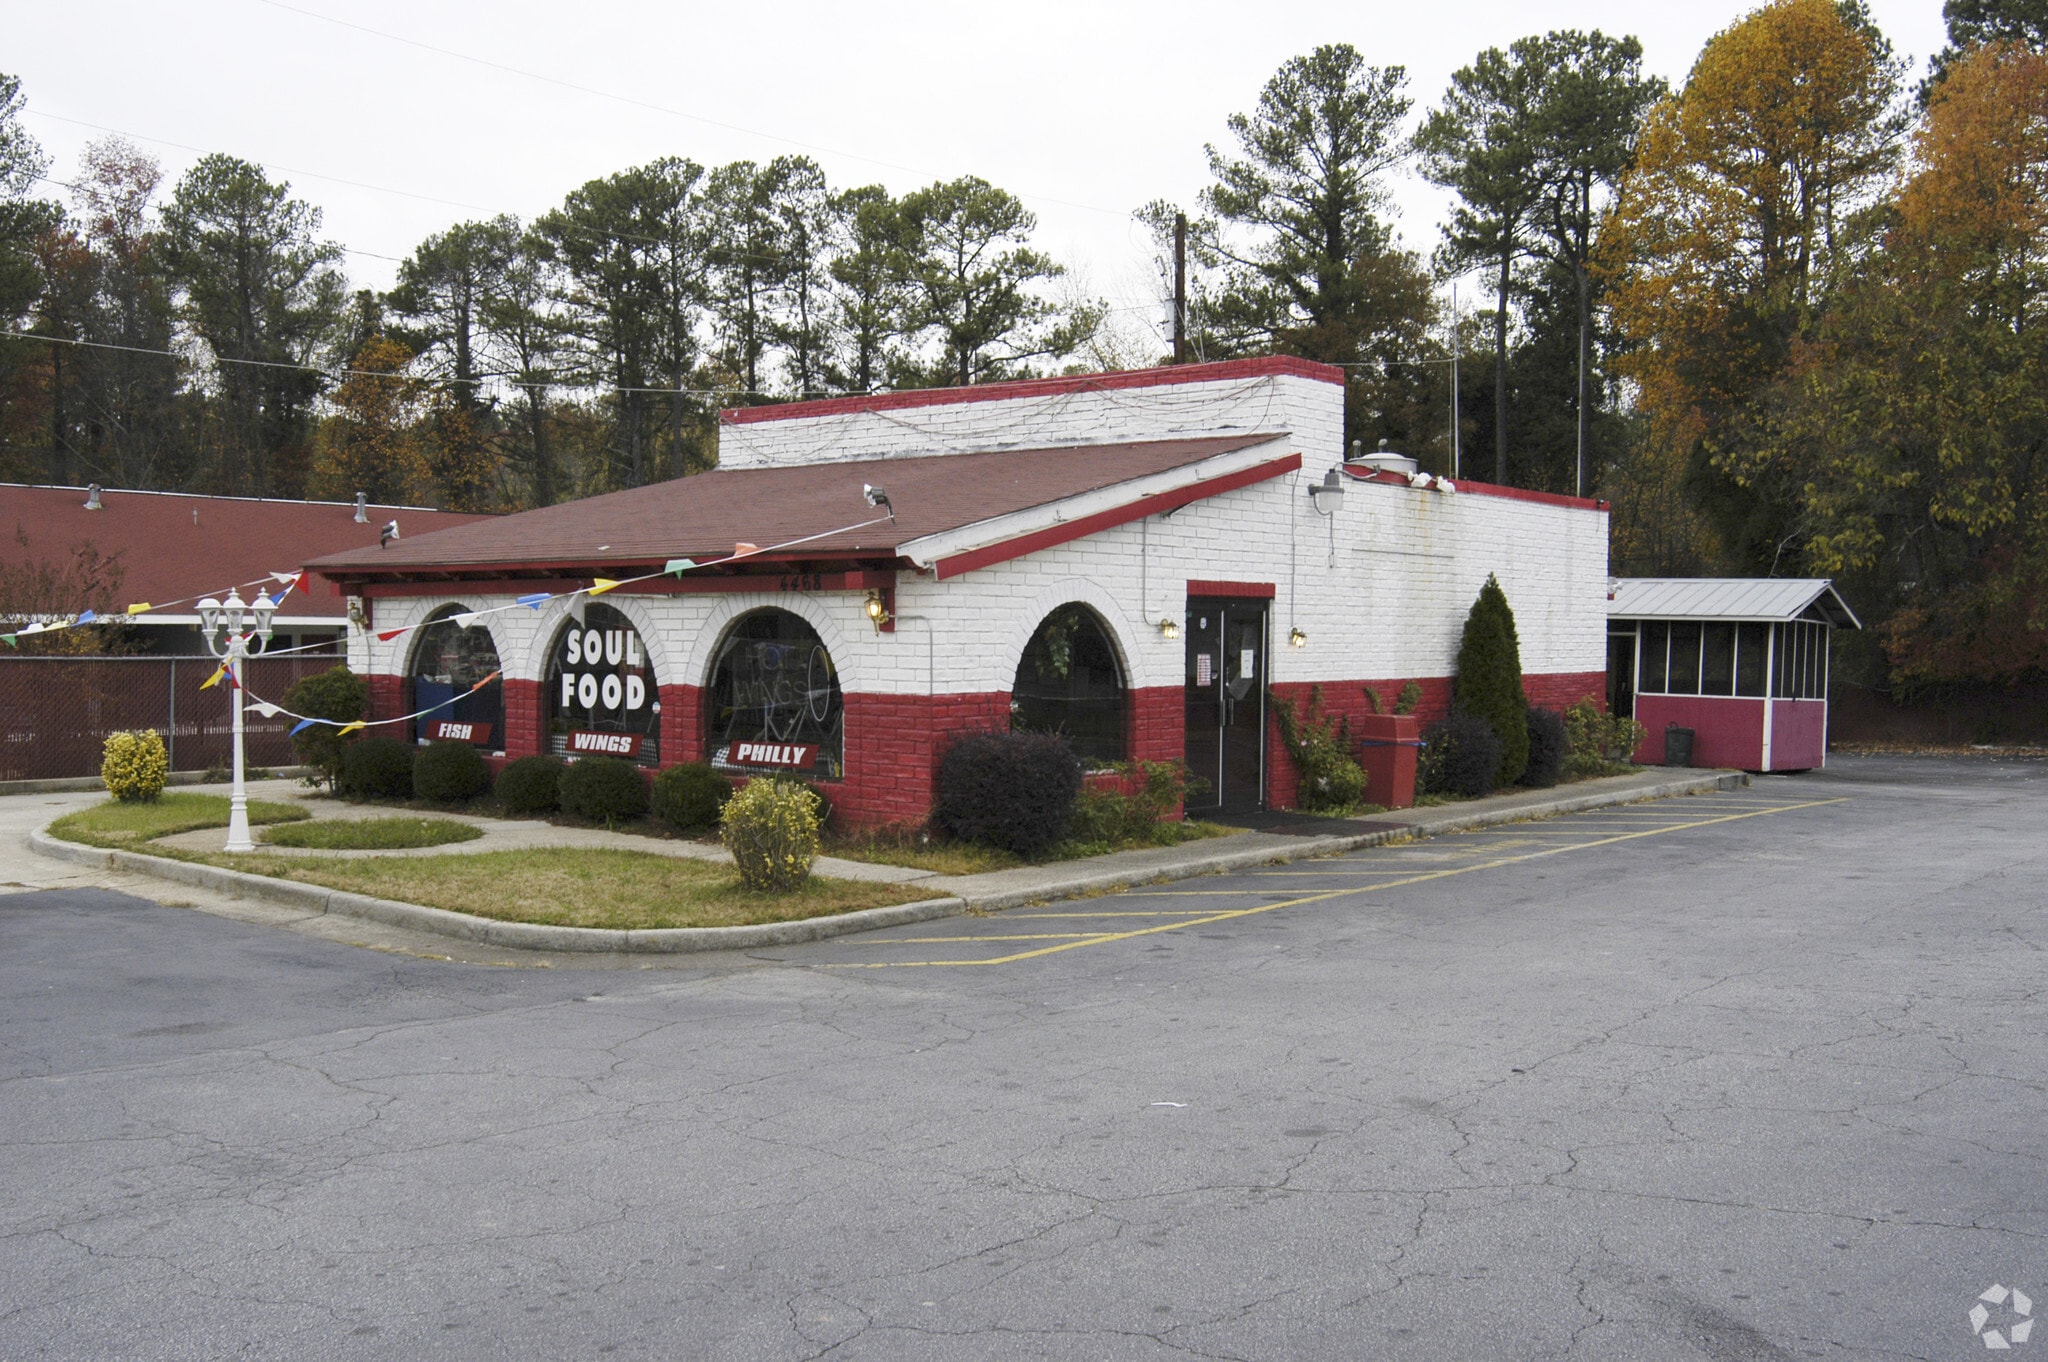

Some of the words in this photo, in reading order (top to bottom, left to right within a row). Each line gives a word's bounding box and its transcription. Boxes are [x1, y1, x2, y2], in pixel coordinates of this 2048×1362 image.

[567, 628, 640, 666] SOUL
[561, 672, 646, 710] FOOD
[438, 722, 473, 740] FISH
[574, 732, 632, 753] WINGS
[737, 743, 807, 765] PHILLY
